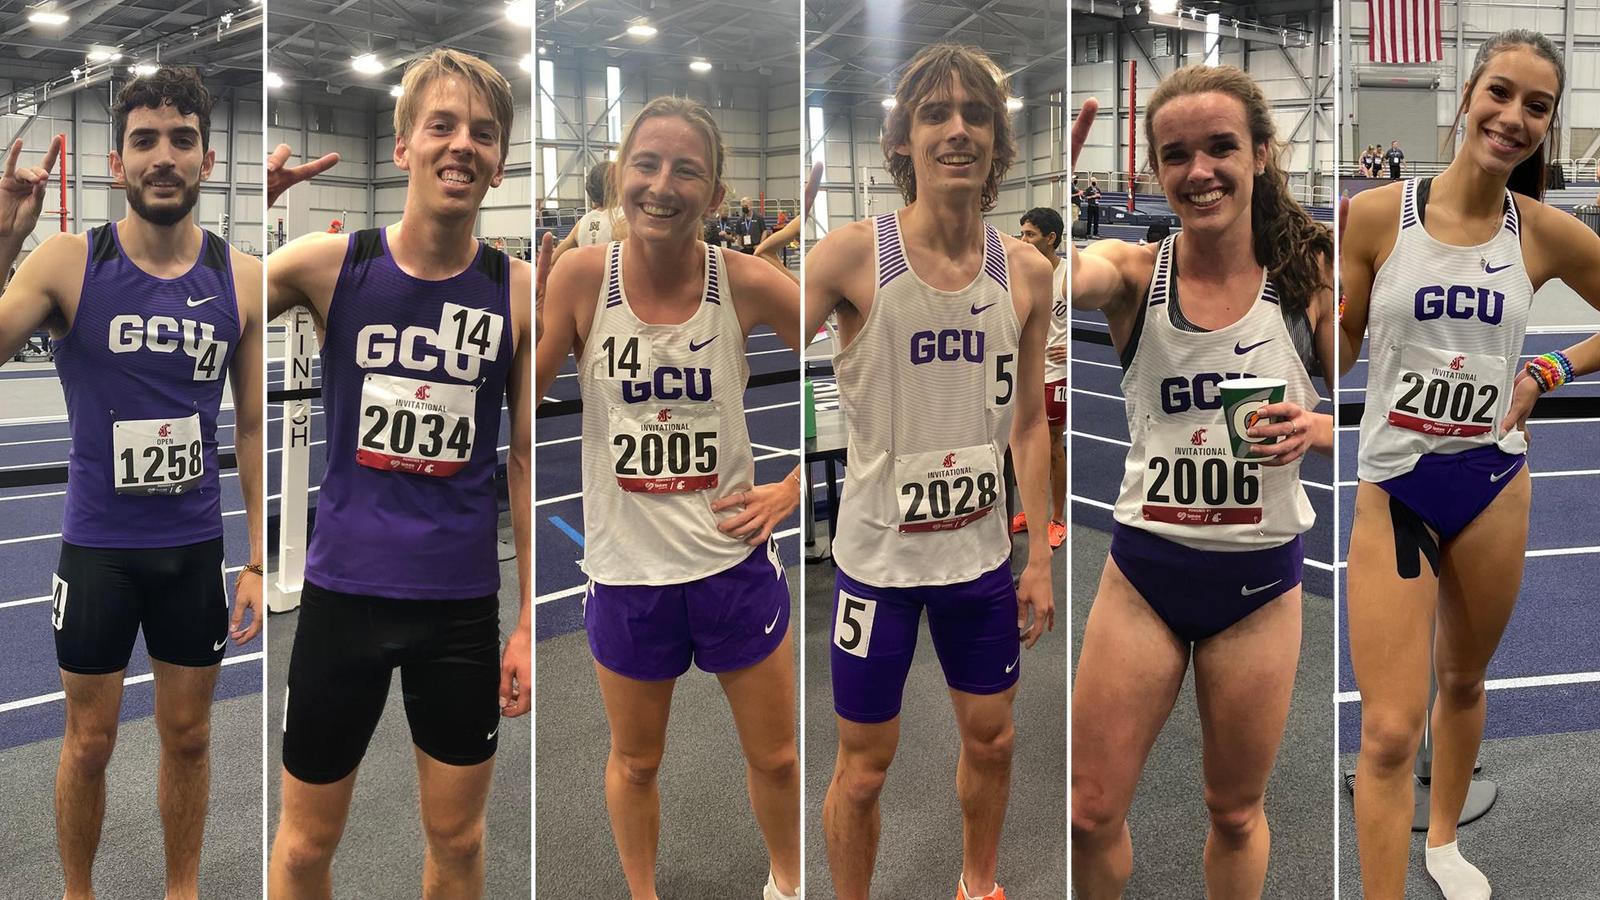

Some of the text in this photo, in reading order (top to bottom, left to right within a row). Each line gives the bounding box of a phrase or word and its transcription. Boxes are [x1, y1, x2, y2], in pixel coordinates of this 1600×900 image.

[1052, 300, 1067, 317] 10
[1414, 285, 1505, 326] GCU
[109, 314, 216, 358] GCU
[452, 308, 492, 356] 14
[910, 329, 986, 366] GCU
[198, 343, 216, 379] 4
[601, 336, 641, 379] 14
[1432, 367, 1478, 382] INVITATIONAL
[996, 353, 1015, 406] 5
[1161, 372, 1258, 414] GC
[1395, 372, 1499, 424] 2002
[395, 398, 447, 413] INVITATIONAL
[156, 438, 174, 446] OPEN
[362, 405, 471, 459] 2034
[641, 423, 690, 432] INVITATIONAL
[120, 440, 202, 485] 1258
[613, 432, 717, 476] 2005
[928, 466, 973, 479] INVITATIONAL
[1175, 447, 1227, 456] INVITATIONAL
[901, 472, 997, 522] 2028
[1147, 456, 1259, 505] 2006
[53, 582, 63, 625] 4
[839, 598, 866, 651] 5
